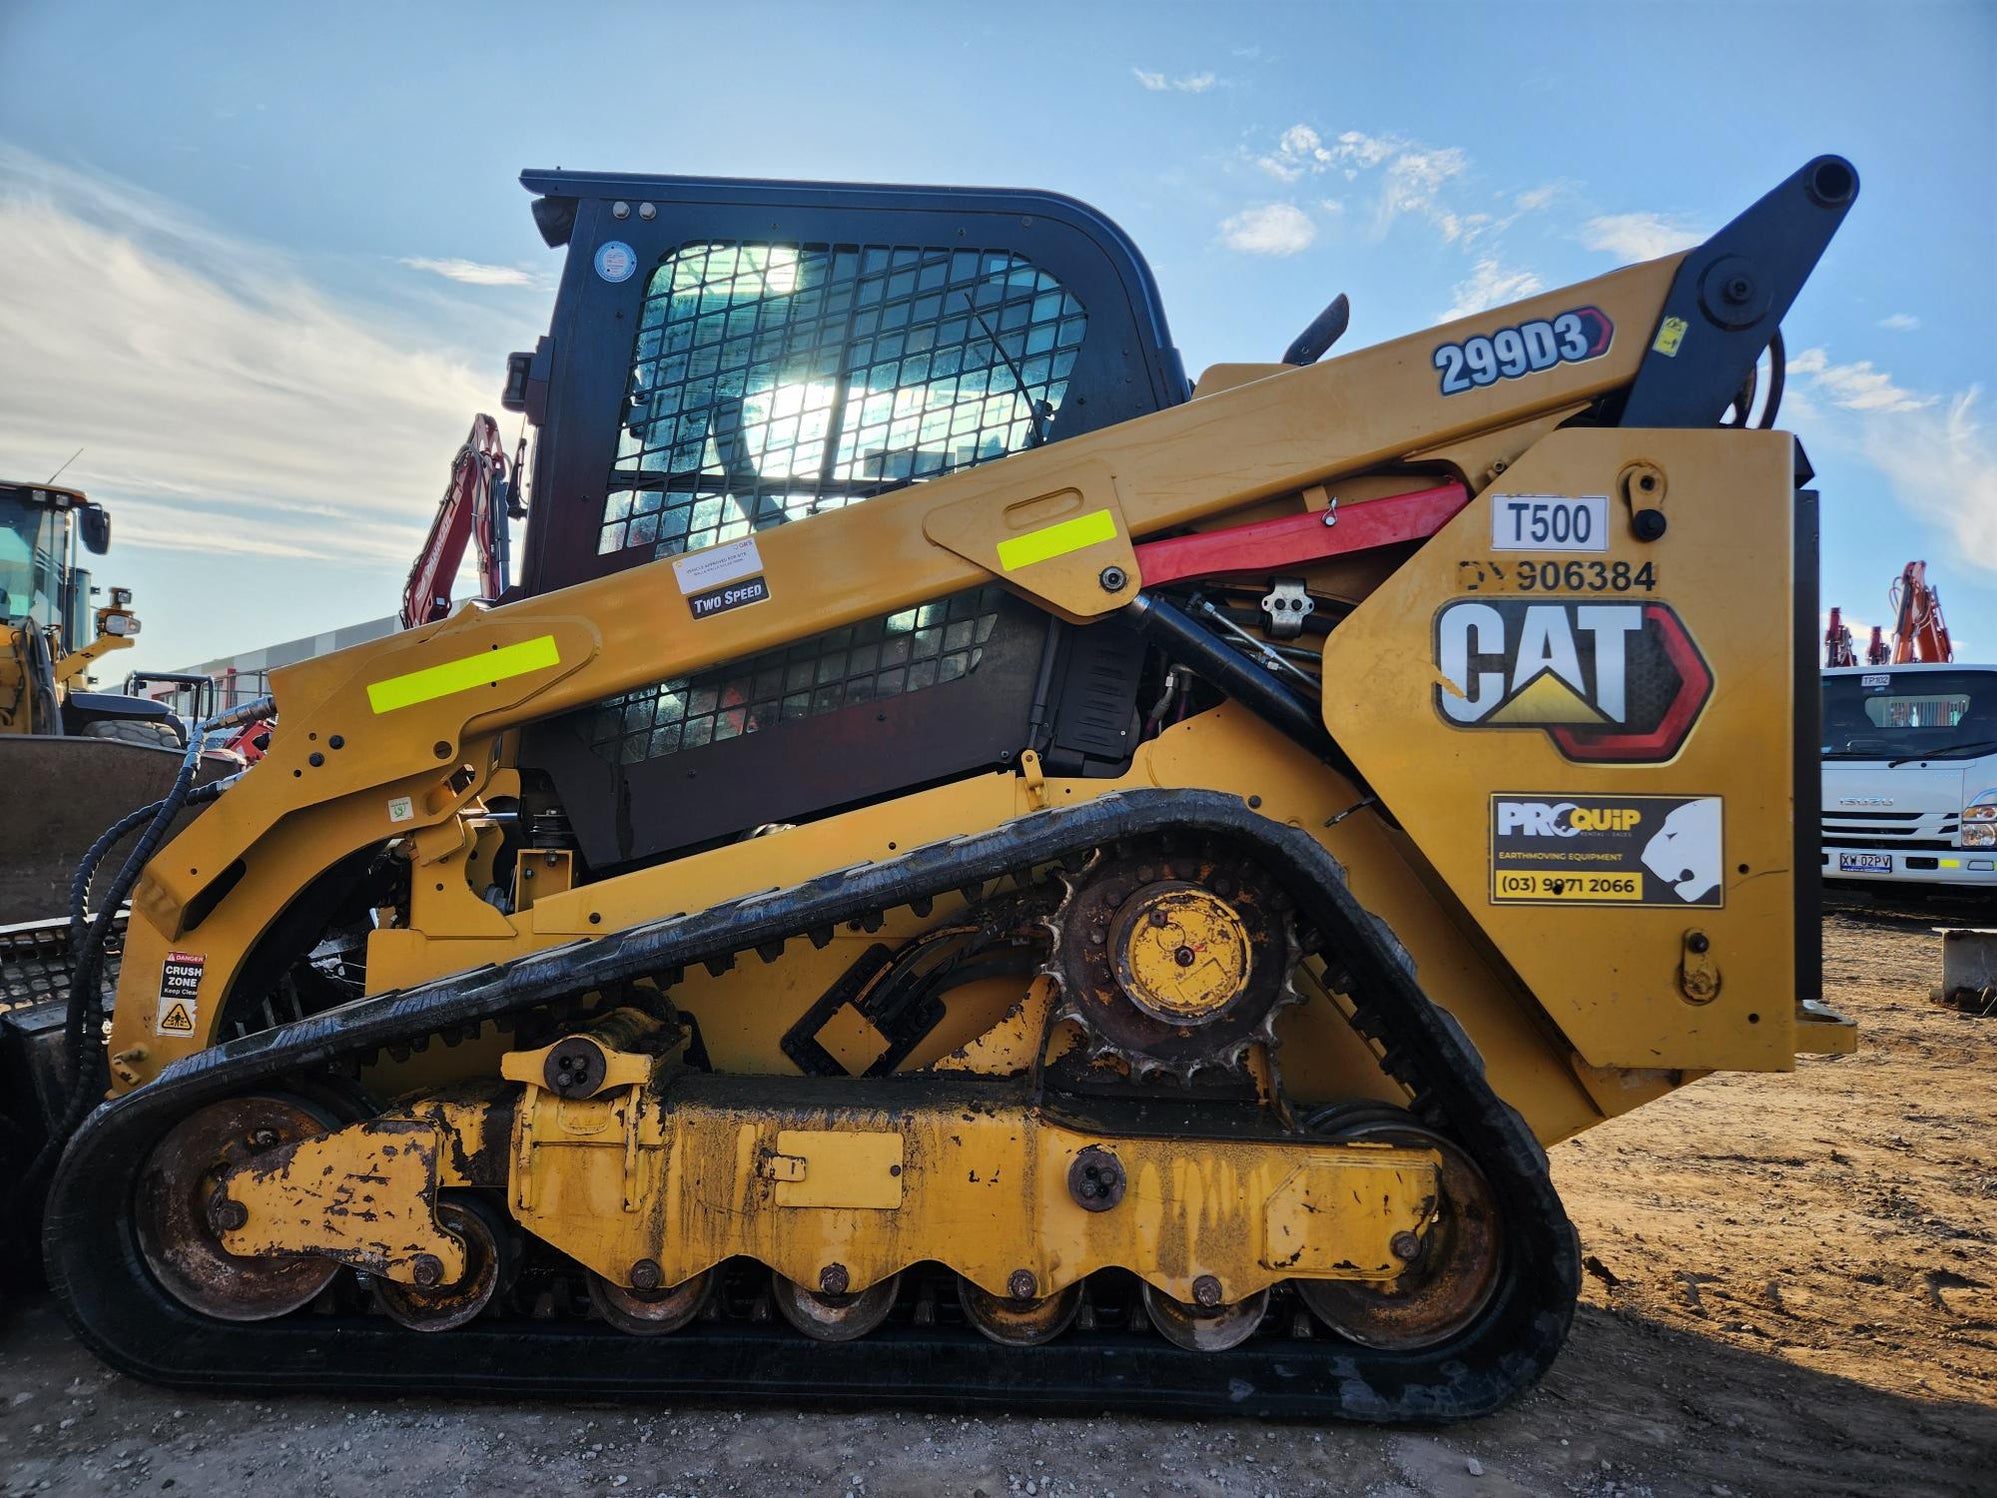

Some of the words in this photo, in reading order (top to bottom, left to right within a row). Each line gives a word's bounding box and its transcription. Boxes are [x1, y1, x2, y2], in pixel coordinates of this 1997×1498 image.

[1434, 313, 1589, 393] 299D3
[1507, 502, 1592, 544] T500
[1516, 560, 1656, 591] 906384
[1440, 603, 1643, 724] CAT
[1499, 852, 1567, 861] EARTHMOVING
[1568, 853, 1623, 863] EQUIPMENT
[1502, 876, 1536, 893] (03)
[1589, 879, 1635, 893] 2066
[165, 965, 202, 977] CRUSH
[168, 976, 197, 987] ZONE
